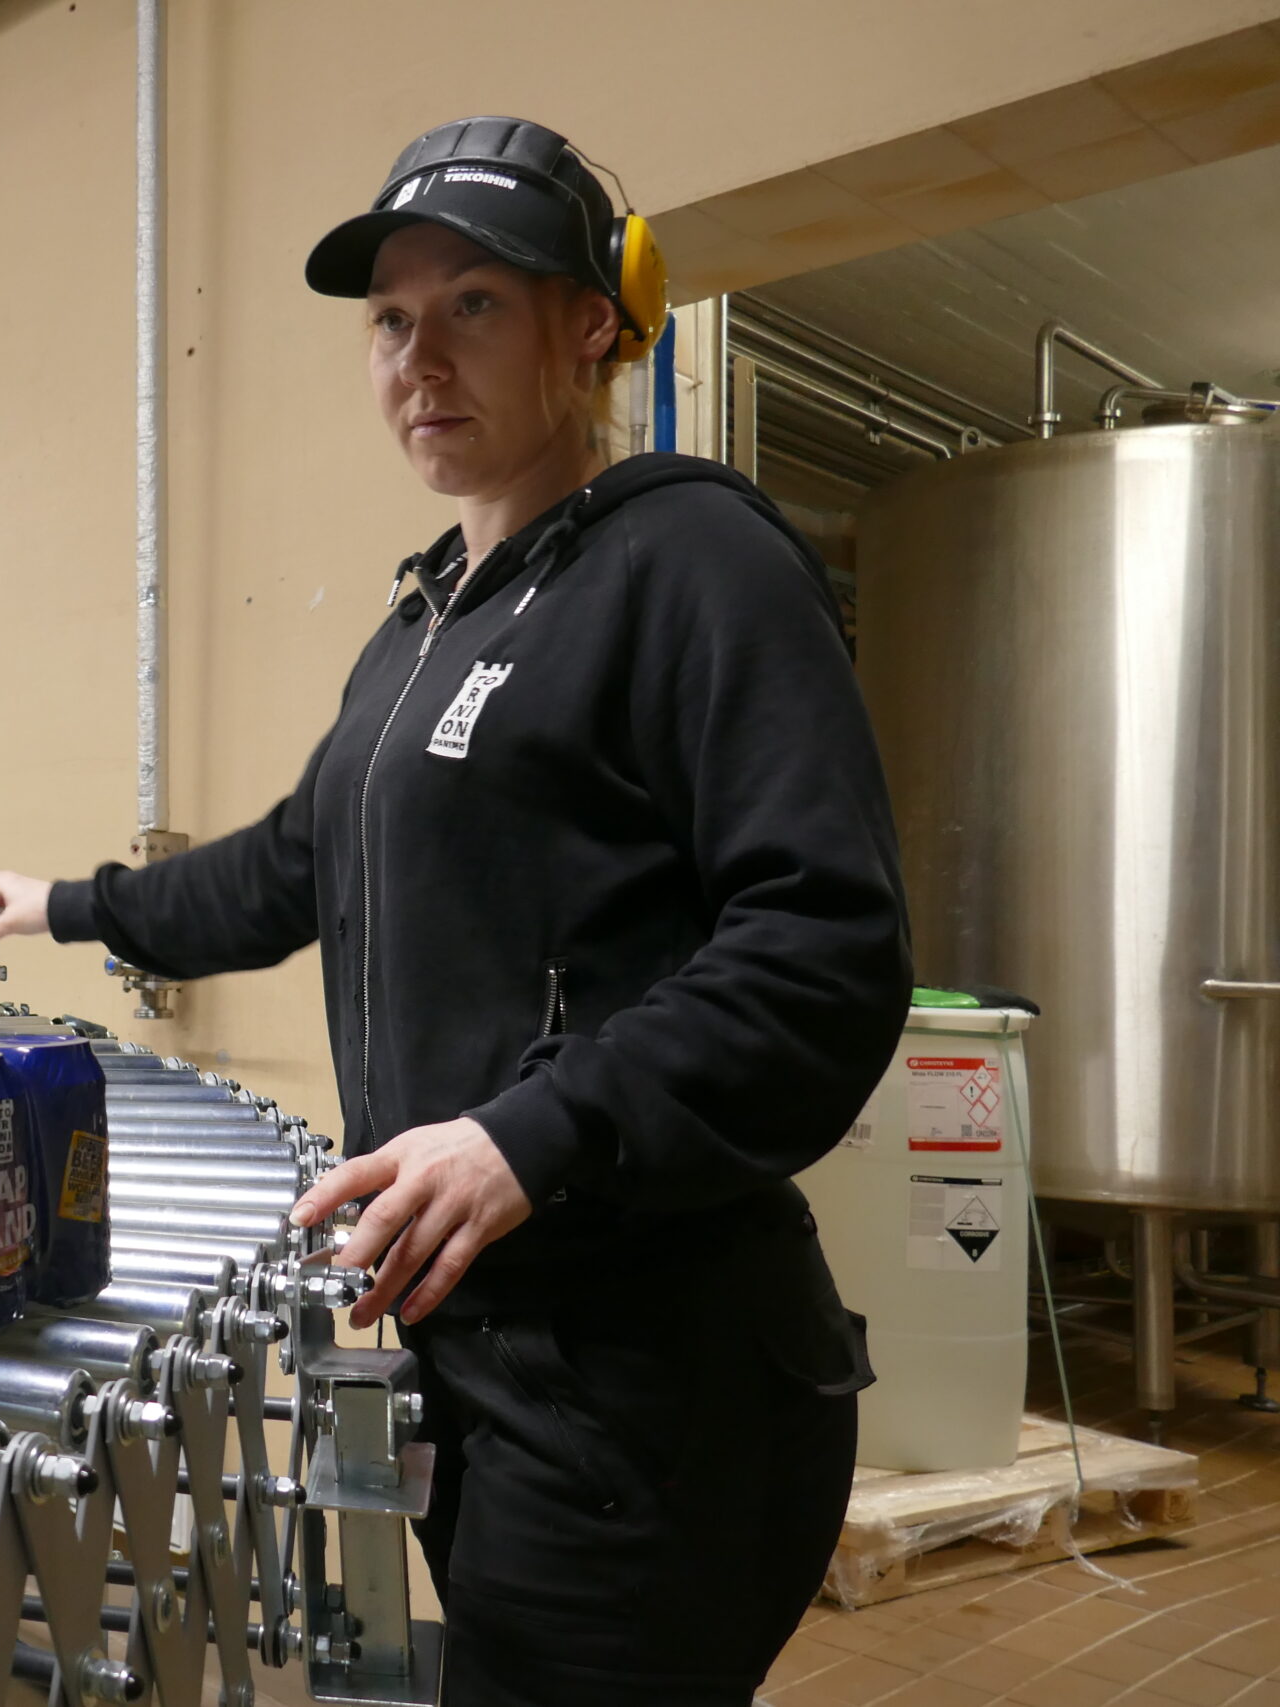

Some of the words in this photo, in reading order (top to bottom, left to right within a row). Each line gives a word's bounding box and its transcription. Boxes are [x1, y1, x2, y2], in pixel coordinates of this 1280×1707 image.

[444, 172, 518, 190] TEKOIHIN
[471, 675, 498, 686] TO
[466, 687, 481, 702] R
[450, 704, 477, 718] NI
[441, 719, 470, 737] ON
